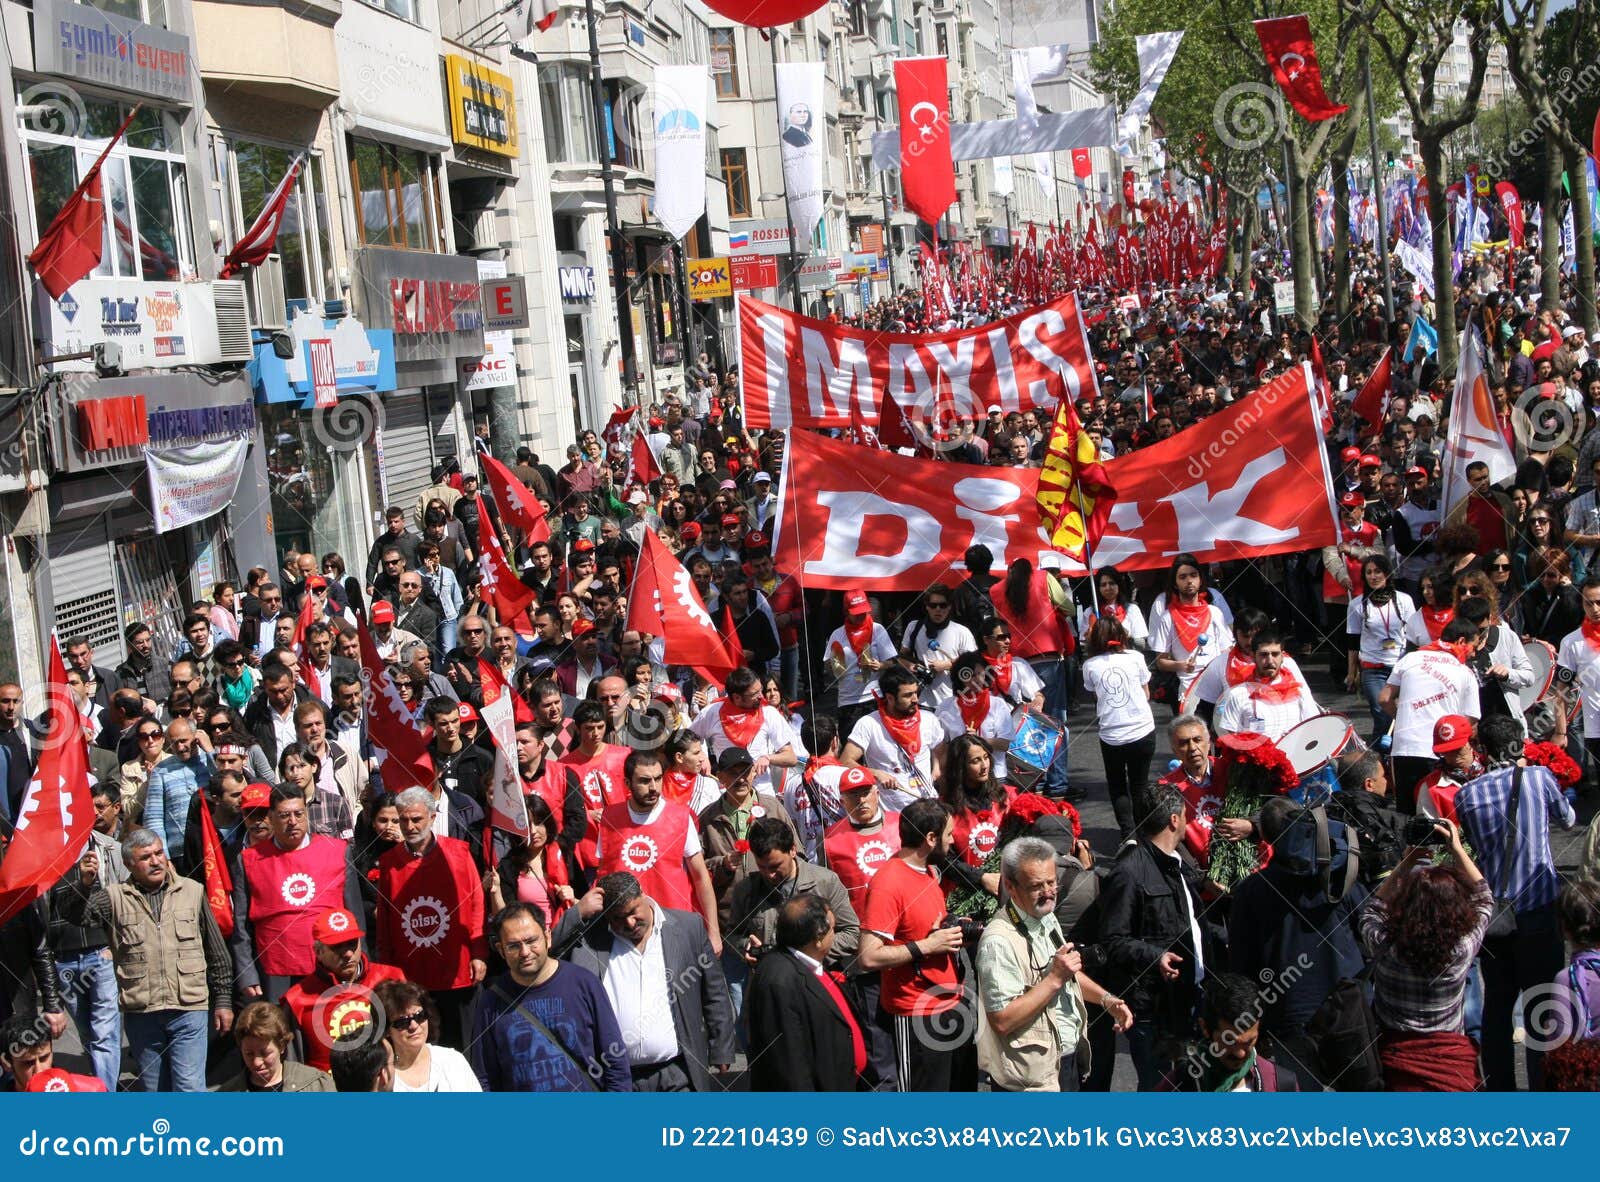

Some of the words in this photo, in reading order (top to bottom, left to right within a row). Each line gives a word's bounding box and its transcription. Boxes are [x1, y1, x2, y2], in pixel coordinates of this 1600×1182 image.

[732, 255, 755, 263] BANK
[560, 267, 595, 299] MNG
[488, 319, 523, 328] PHARMACY
[463, 360, 507, 373] GNC
[800, 309, 1081, 418] MAYIS
[487, 372, 508, 383] Well
